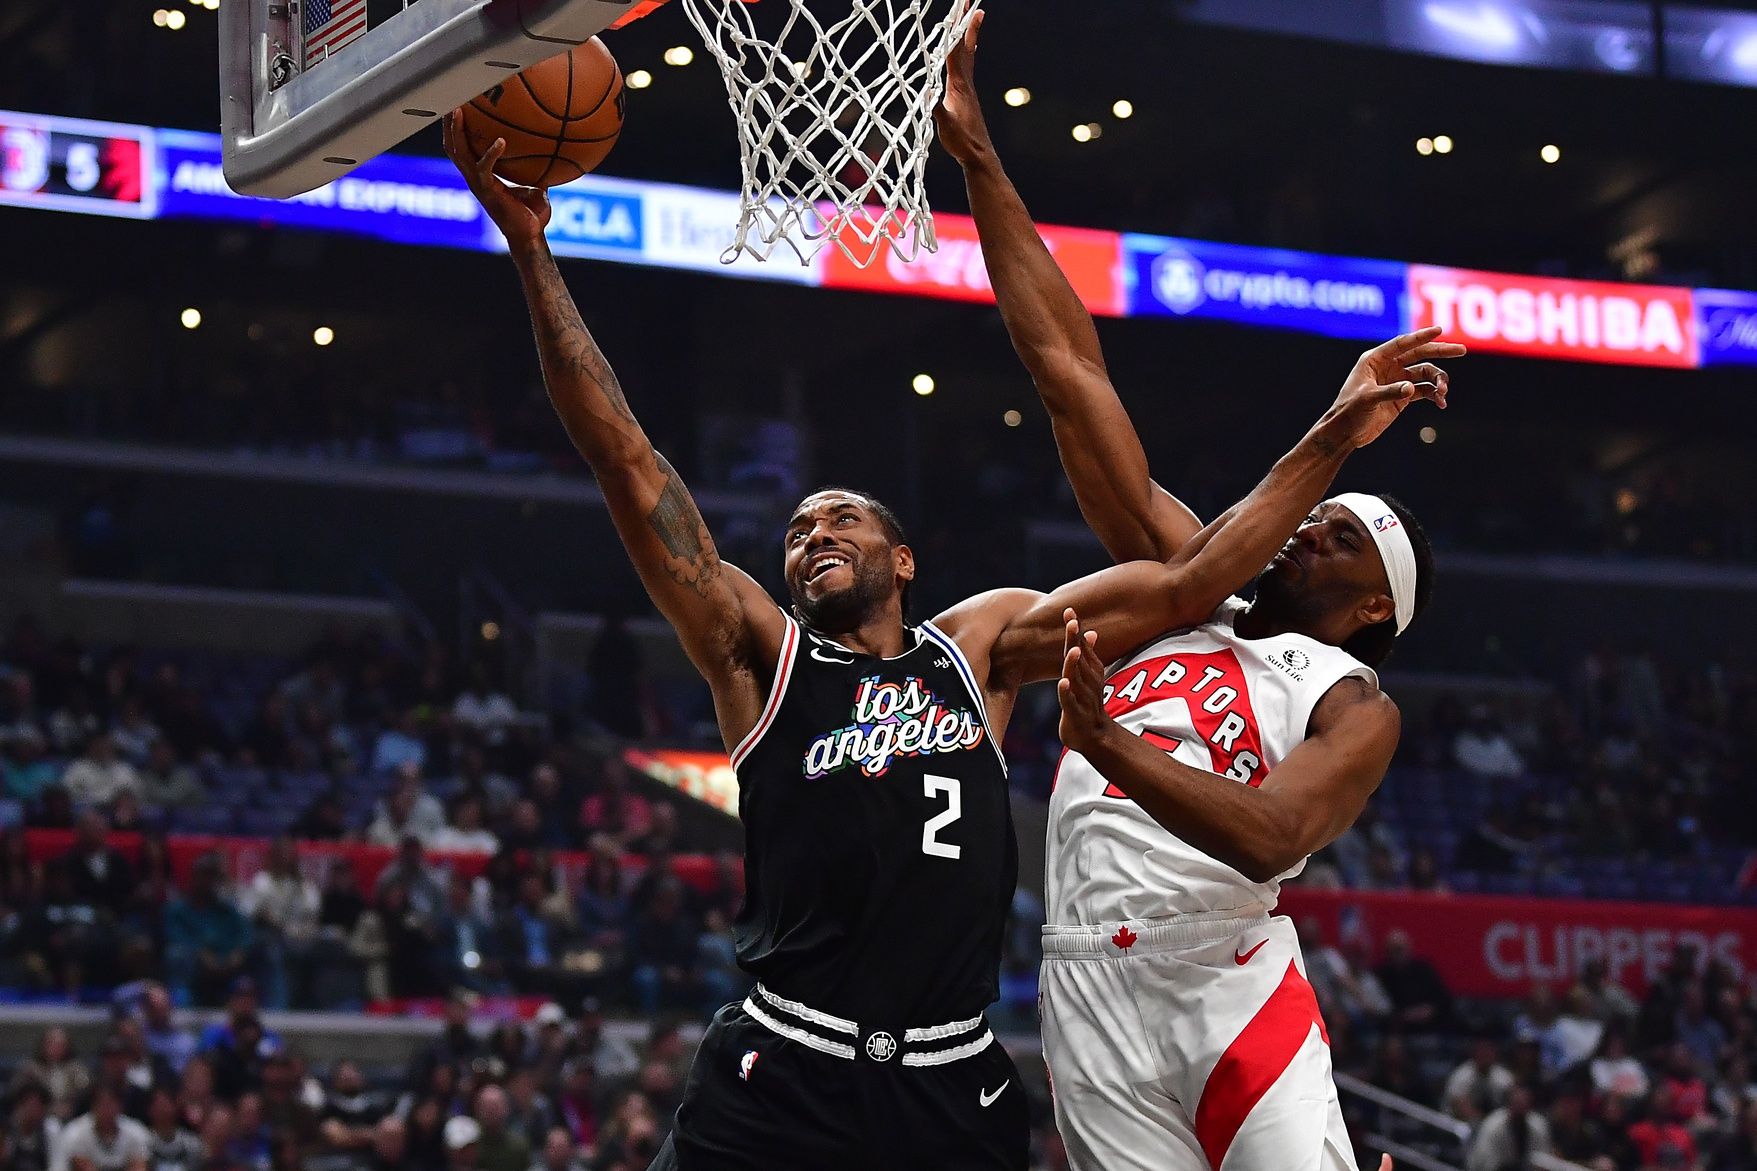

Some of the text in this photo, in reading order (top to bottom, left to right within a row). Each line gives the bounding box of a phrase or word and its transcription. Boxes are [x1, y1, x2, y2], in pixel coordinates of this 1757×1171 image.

[1203, 269, 1385, 317] crypto.com
[1421, 284, 1684, 354] TOSHIBA
[1264, 654, 1304, 683] Sun Life
[854, 680, 931, 724] los
[805, 704, 981, 775] angeles
[922, 773, 962, 860] 2
